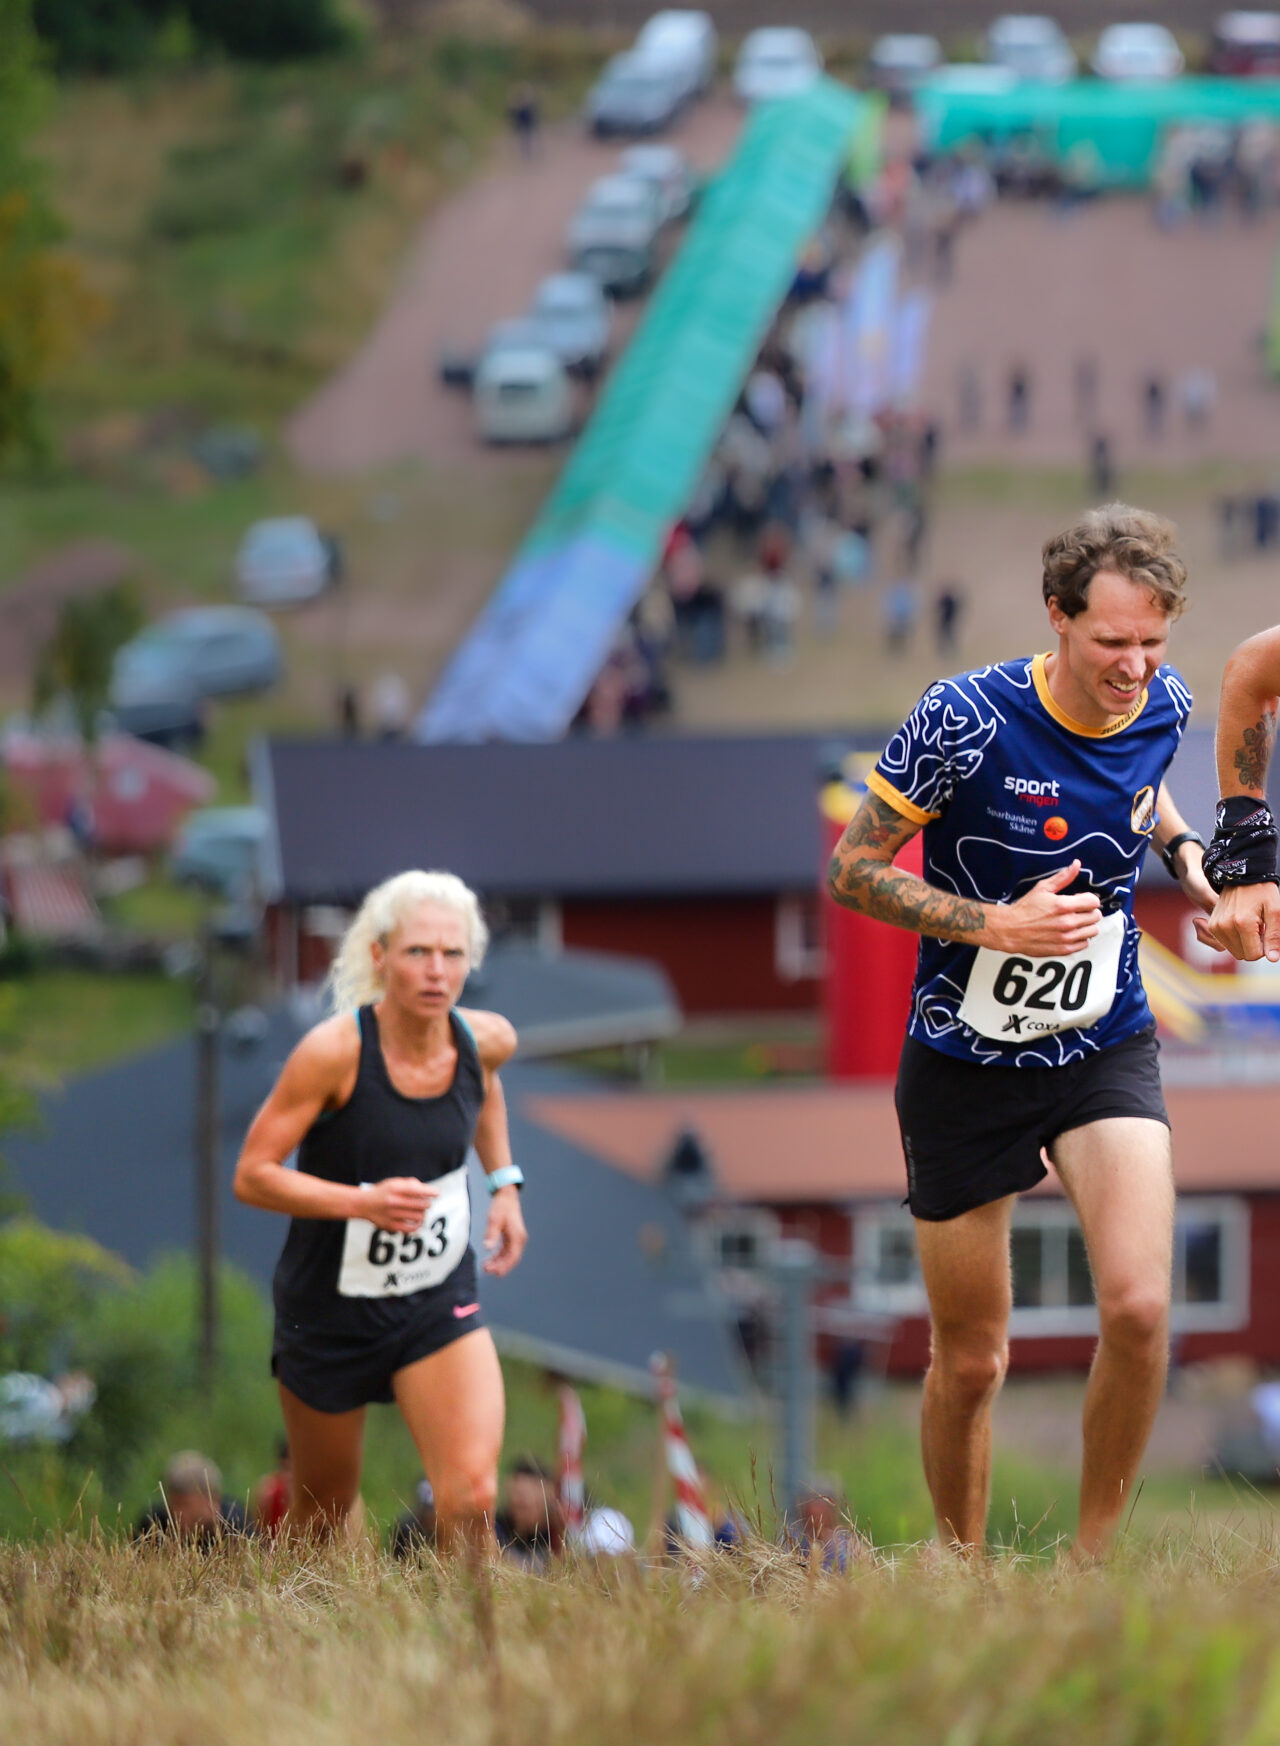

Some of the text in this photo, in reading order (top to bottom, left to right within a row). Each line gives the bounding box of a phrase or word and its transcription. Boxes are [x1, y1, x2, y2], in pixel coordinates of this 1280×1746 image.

[1003, 775, 1060, 797] sport
[1018, 793, 1059, 808] ringen
[986, 805, 1037, 826] Sparbanken
[993, 957, 1092, 1011] 620
[1026, 1020, 1060, 1031] COXA
[368, 1217, 448, 1265] 653
